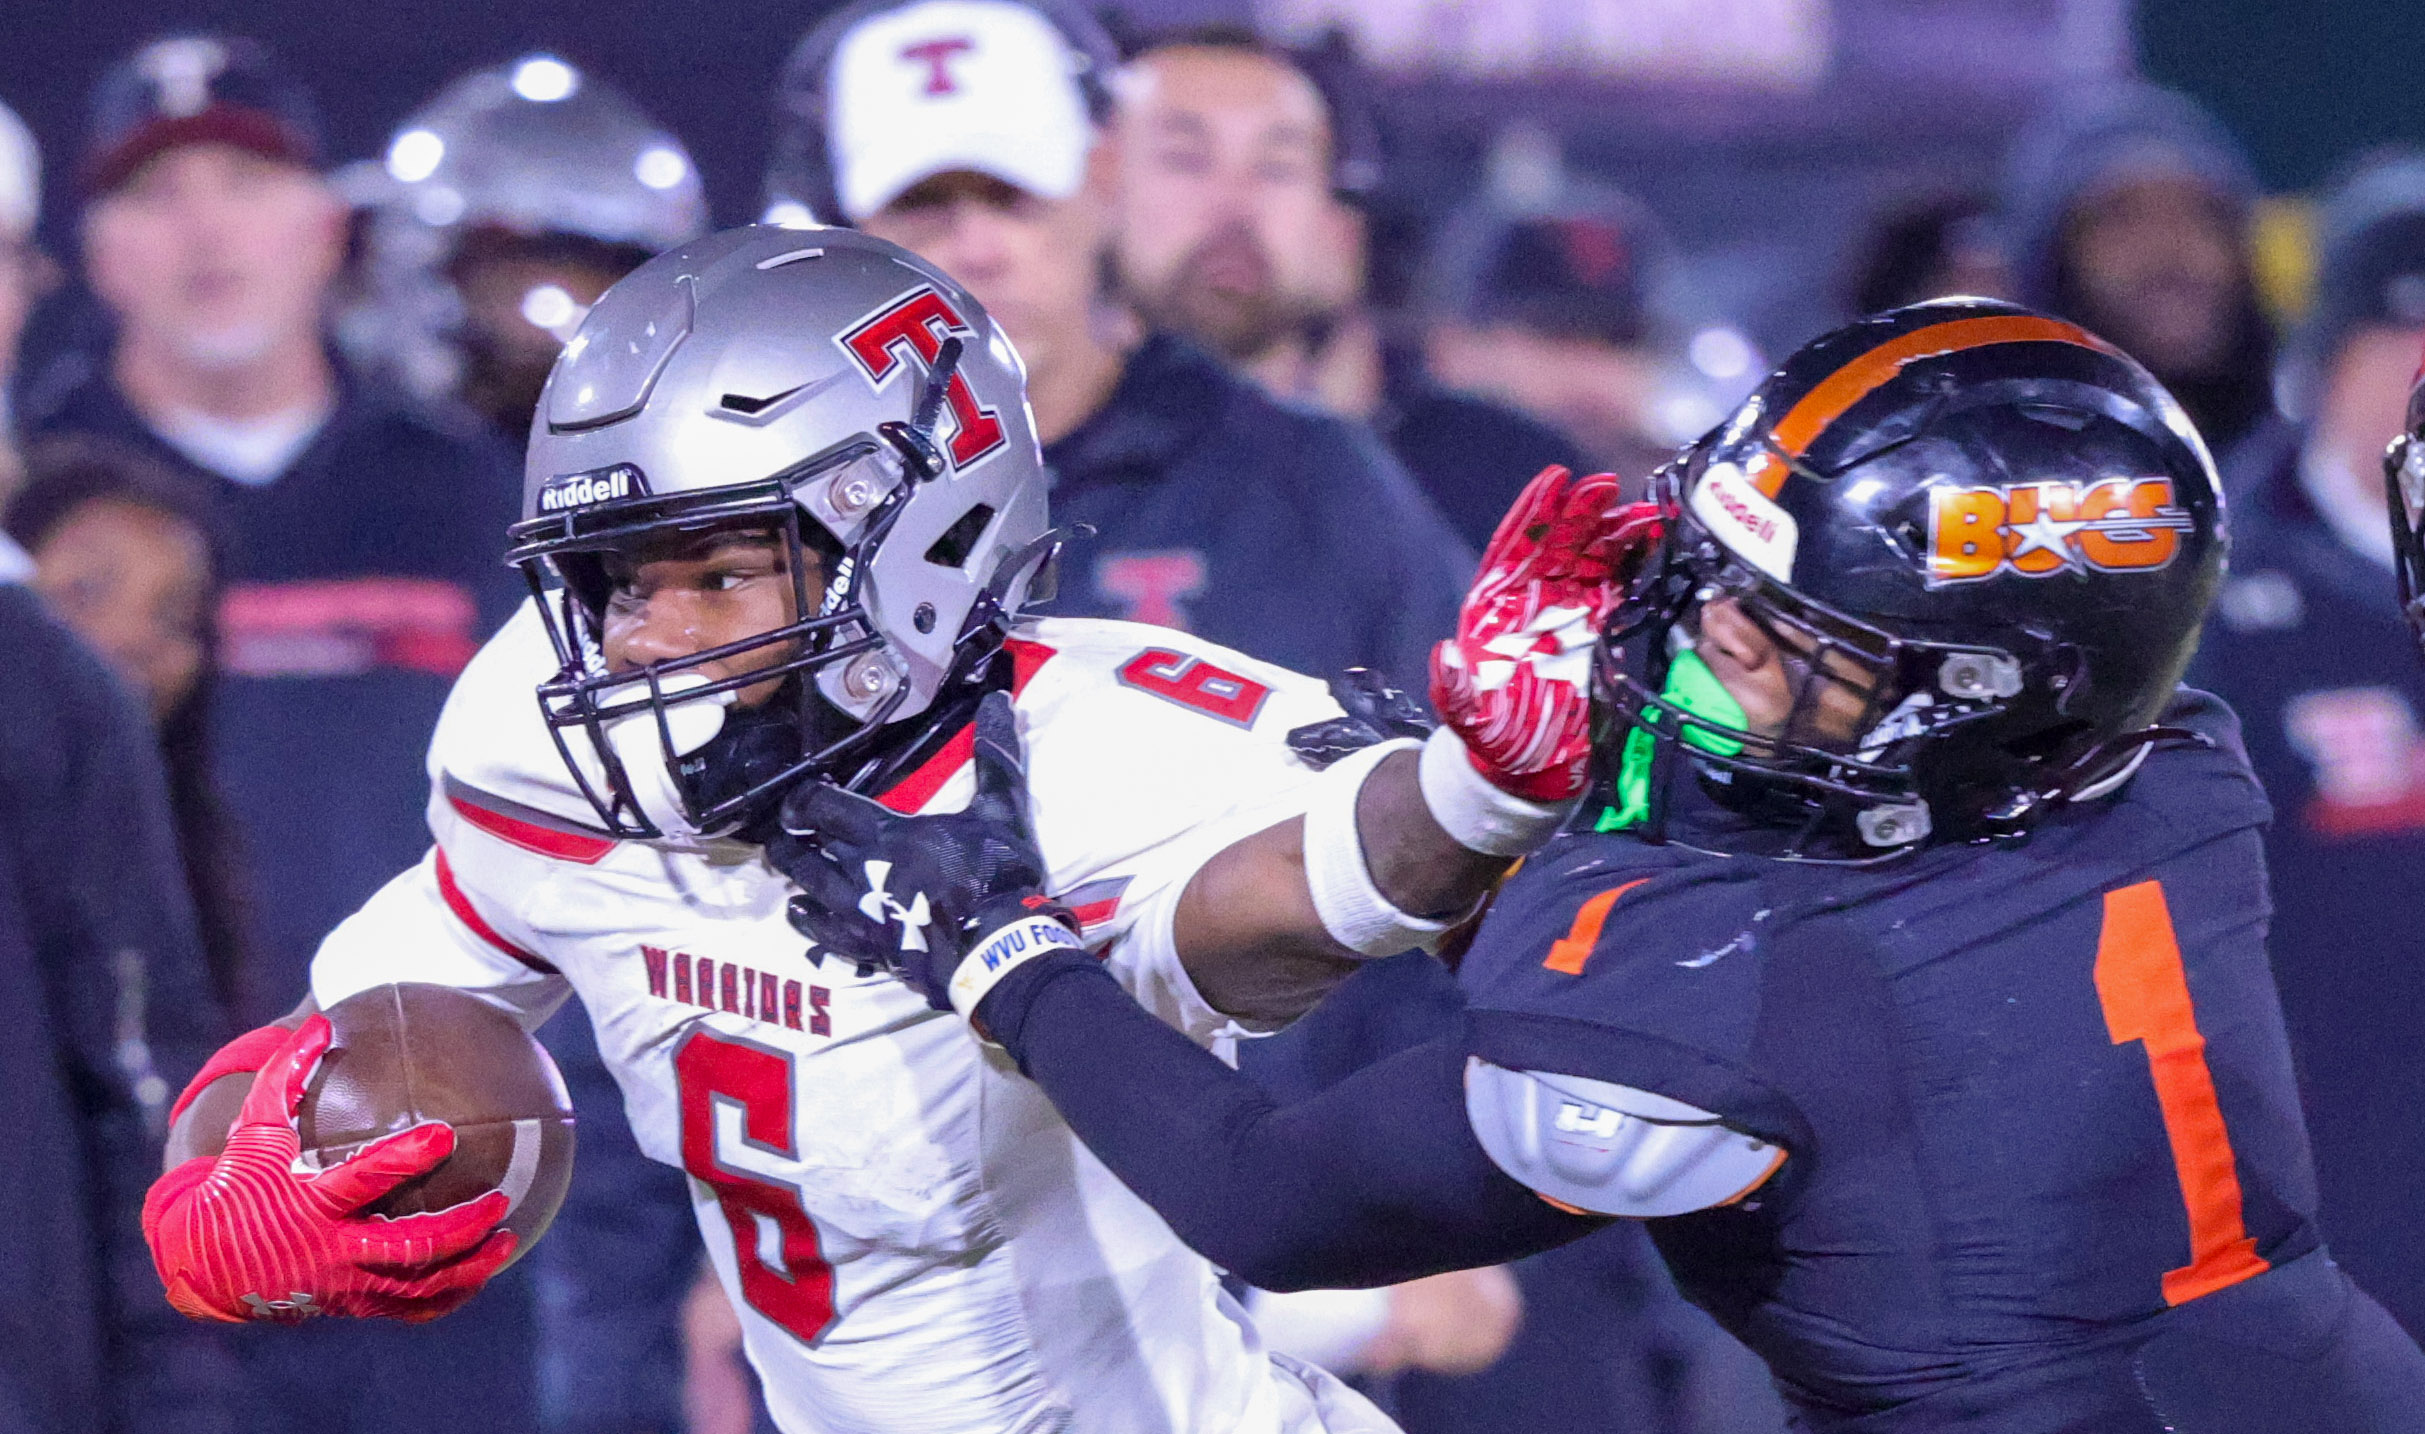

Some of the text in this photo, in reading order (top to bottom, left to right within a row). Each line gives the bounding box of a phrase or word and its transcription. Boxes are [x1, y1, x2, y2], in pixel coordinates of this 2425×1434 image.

[900, 38, 974, 96] T
[832, 283, 1011, 481] T
[542, 468, 629, 511] Riddell
[1097, 551, 1205, 632] T
[1114, 646, 1277, 732] 6
[980, 929, 1027, 973] WVU
[1542, 877, 1652, 976] 1
[641, 944, 832, 1038] WARRIORS
[2093, 879, 2270, 1307] 1
[672, 1020, 838, 1349] 6
